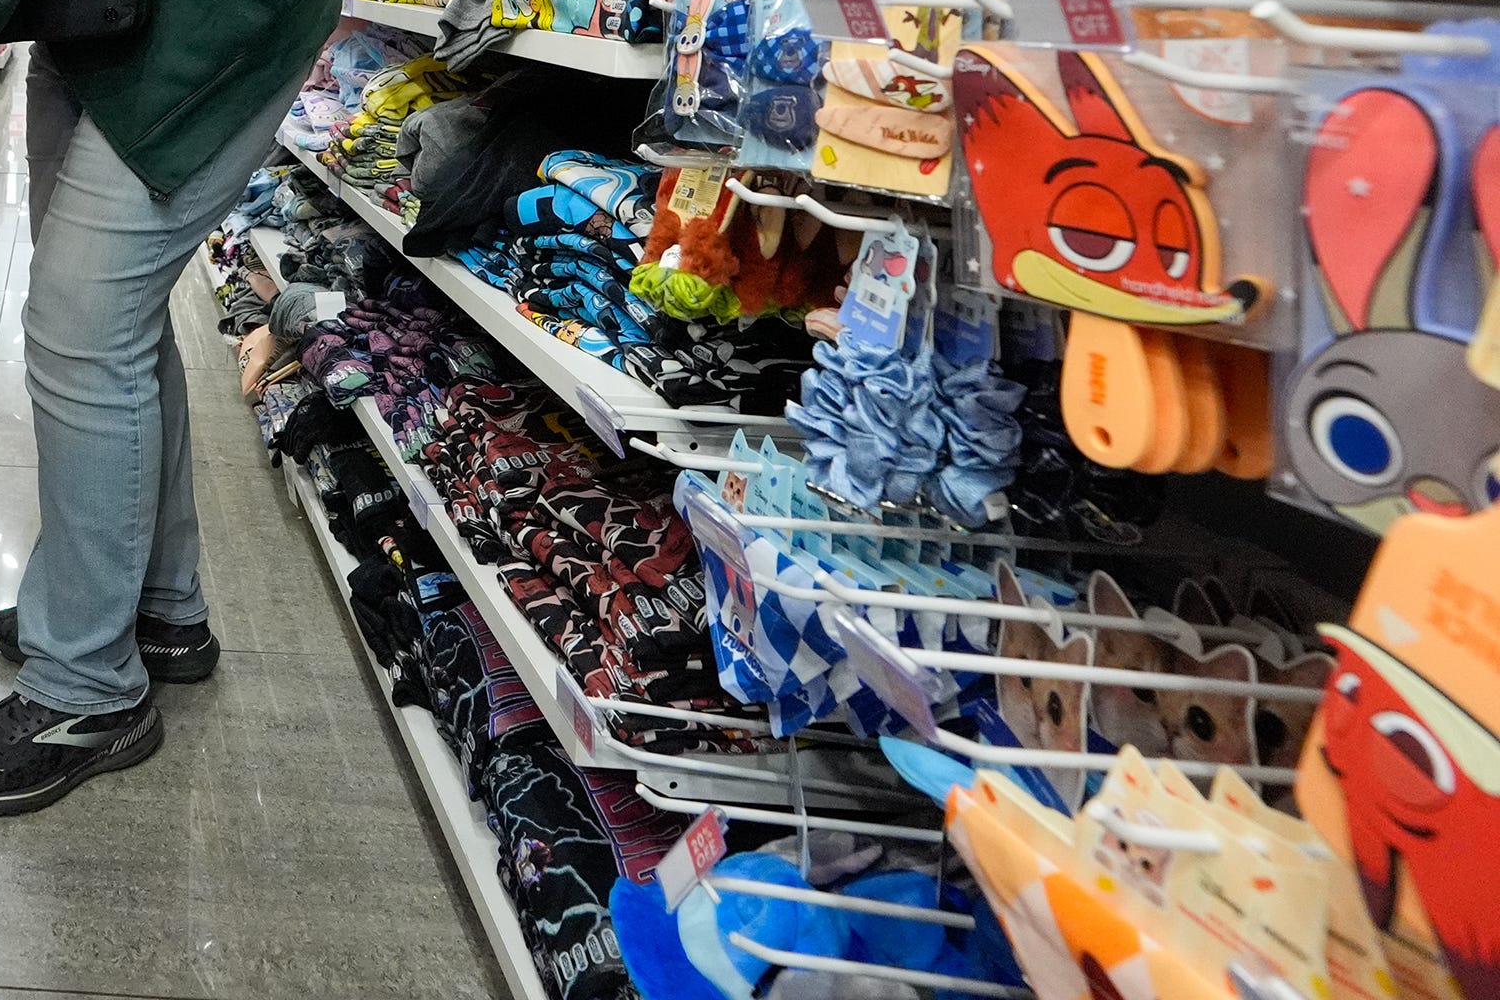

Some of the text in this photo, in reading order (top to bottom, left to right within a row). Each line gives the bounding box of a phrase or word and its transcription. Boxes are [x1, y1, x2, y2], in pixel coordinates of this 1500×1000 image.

[850, 20, 879, 36] OFF
[40, 727, 62, 741] BROOKS
[691, 827, 714, 855] 20%
[697, 840, 718, 868] OFF
